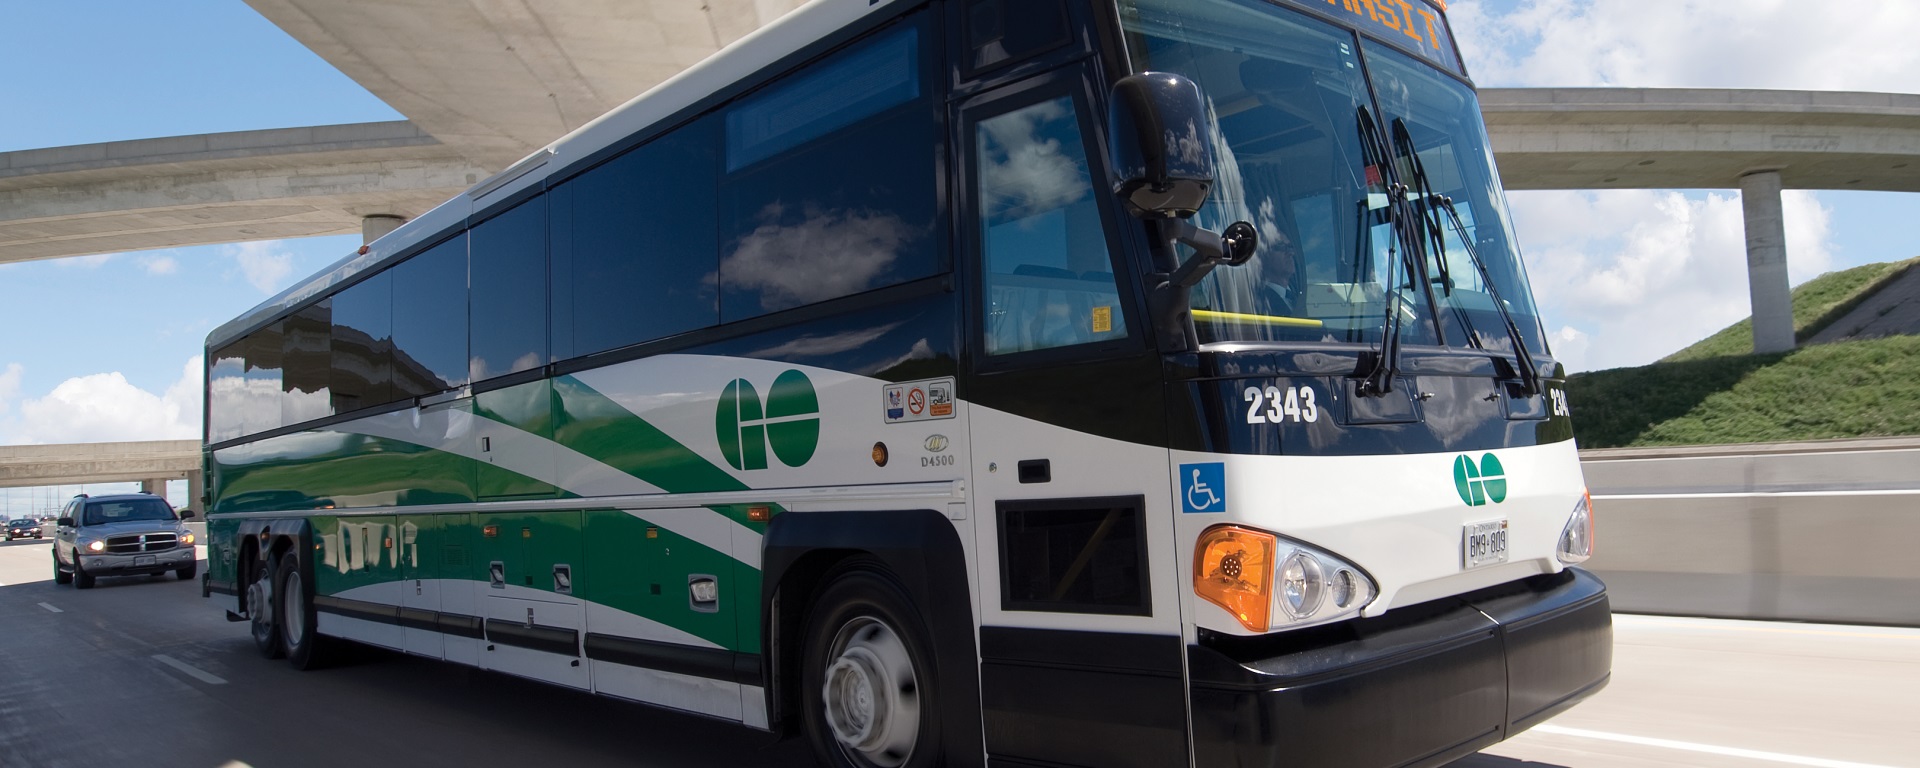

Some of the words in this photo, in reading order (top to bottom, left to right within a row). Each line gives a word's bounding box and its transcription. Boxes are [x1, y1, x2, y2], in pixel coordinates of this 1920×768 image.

[1244, 386, 1318, 424] 2343
[1550, 388, 1570, 417] 234
[716, 369, 820, 471] GO
[921, 455, 955, 467] D4500
